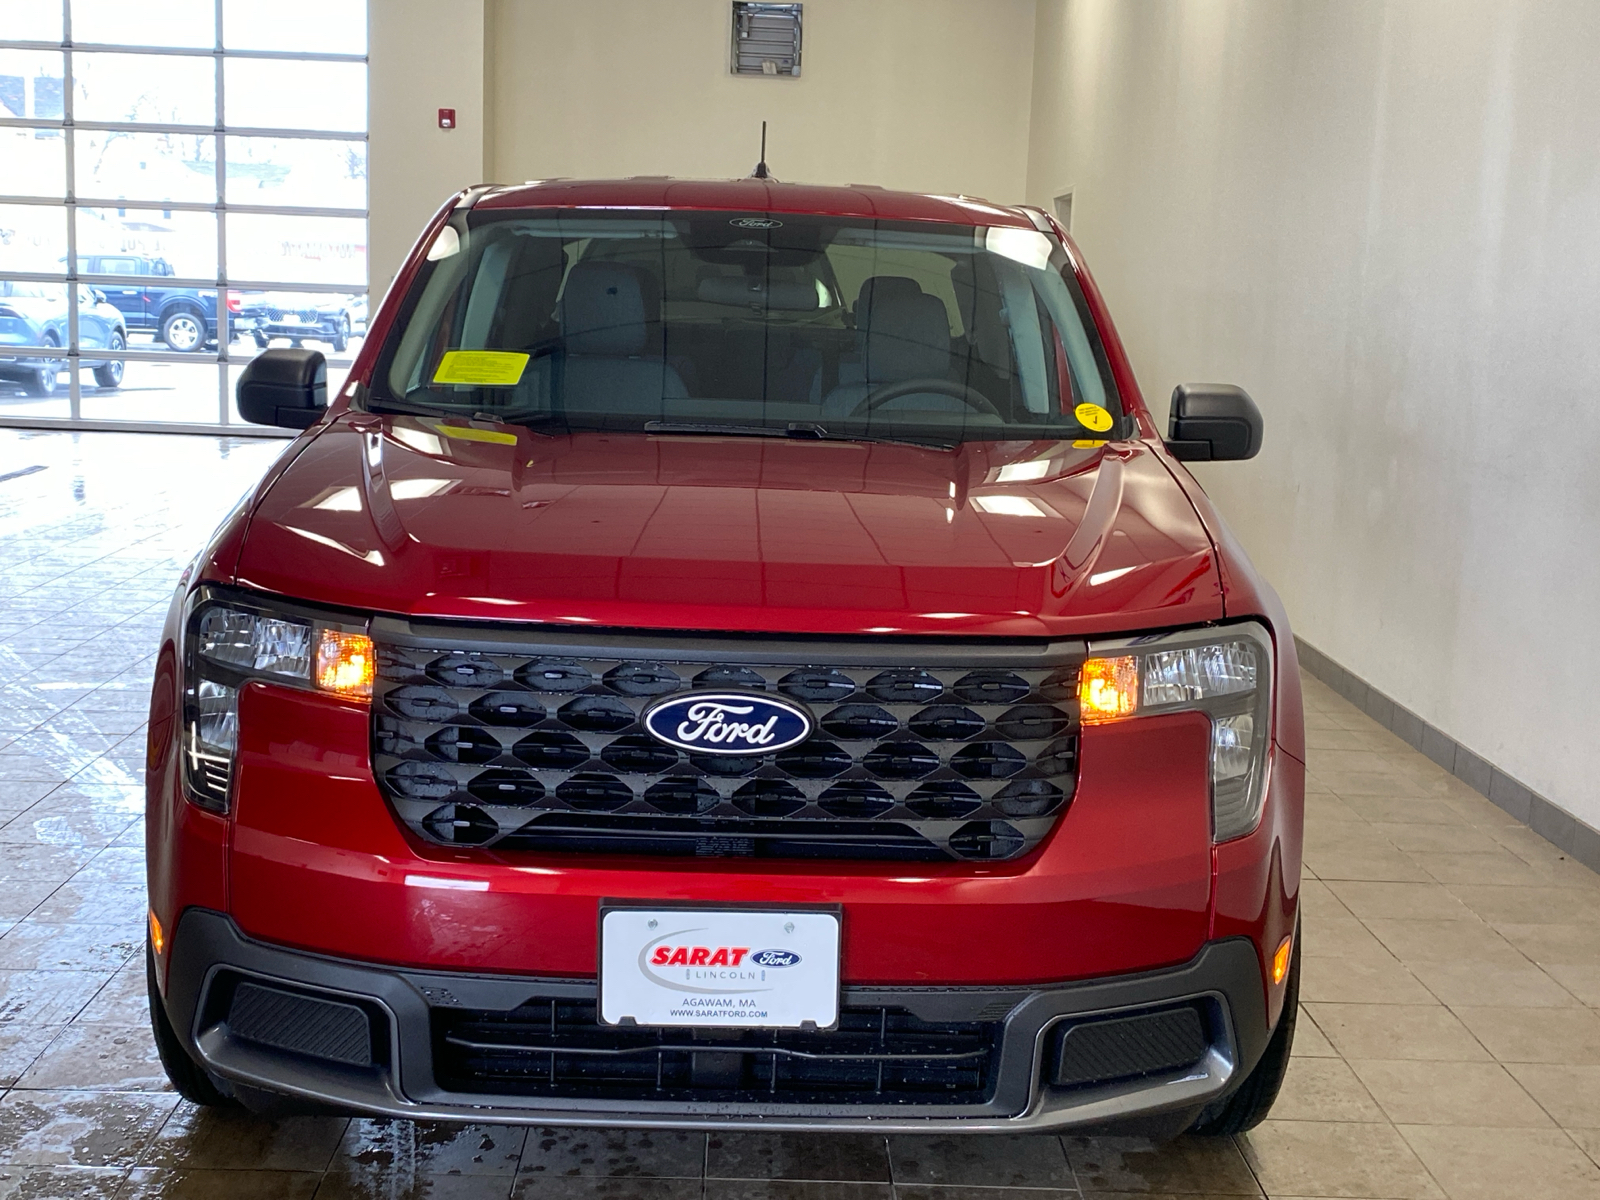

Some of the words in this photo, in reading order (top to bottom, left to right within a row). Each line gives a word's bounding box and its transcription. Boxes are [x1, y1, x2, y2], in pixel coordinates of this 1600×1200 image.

[738, 218, 774, 228] Ford
[677, 702, 779, 745] Ford
[650, 945, 751, 968] SARAT
[759, 951, 793, 966] Ford
[695, 971, 756, 980] LINCOLN
[682, 998, 736, 1009] AGAWAM,
[738, 999, 757, 1008] MA
[670, 1009, 768, 1018] WWW.SARATFORD.COM
